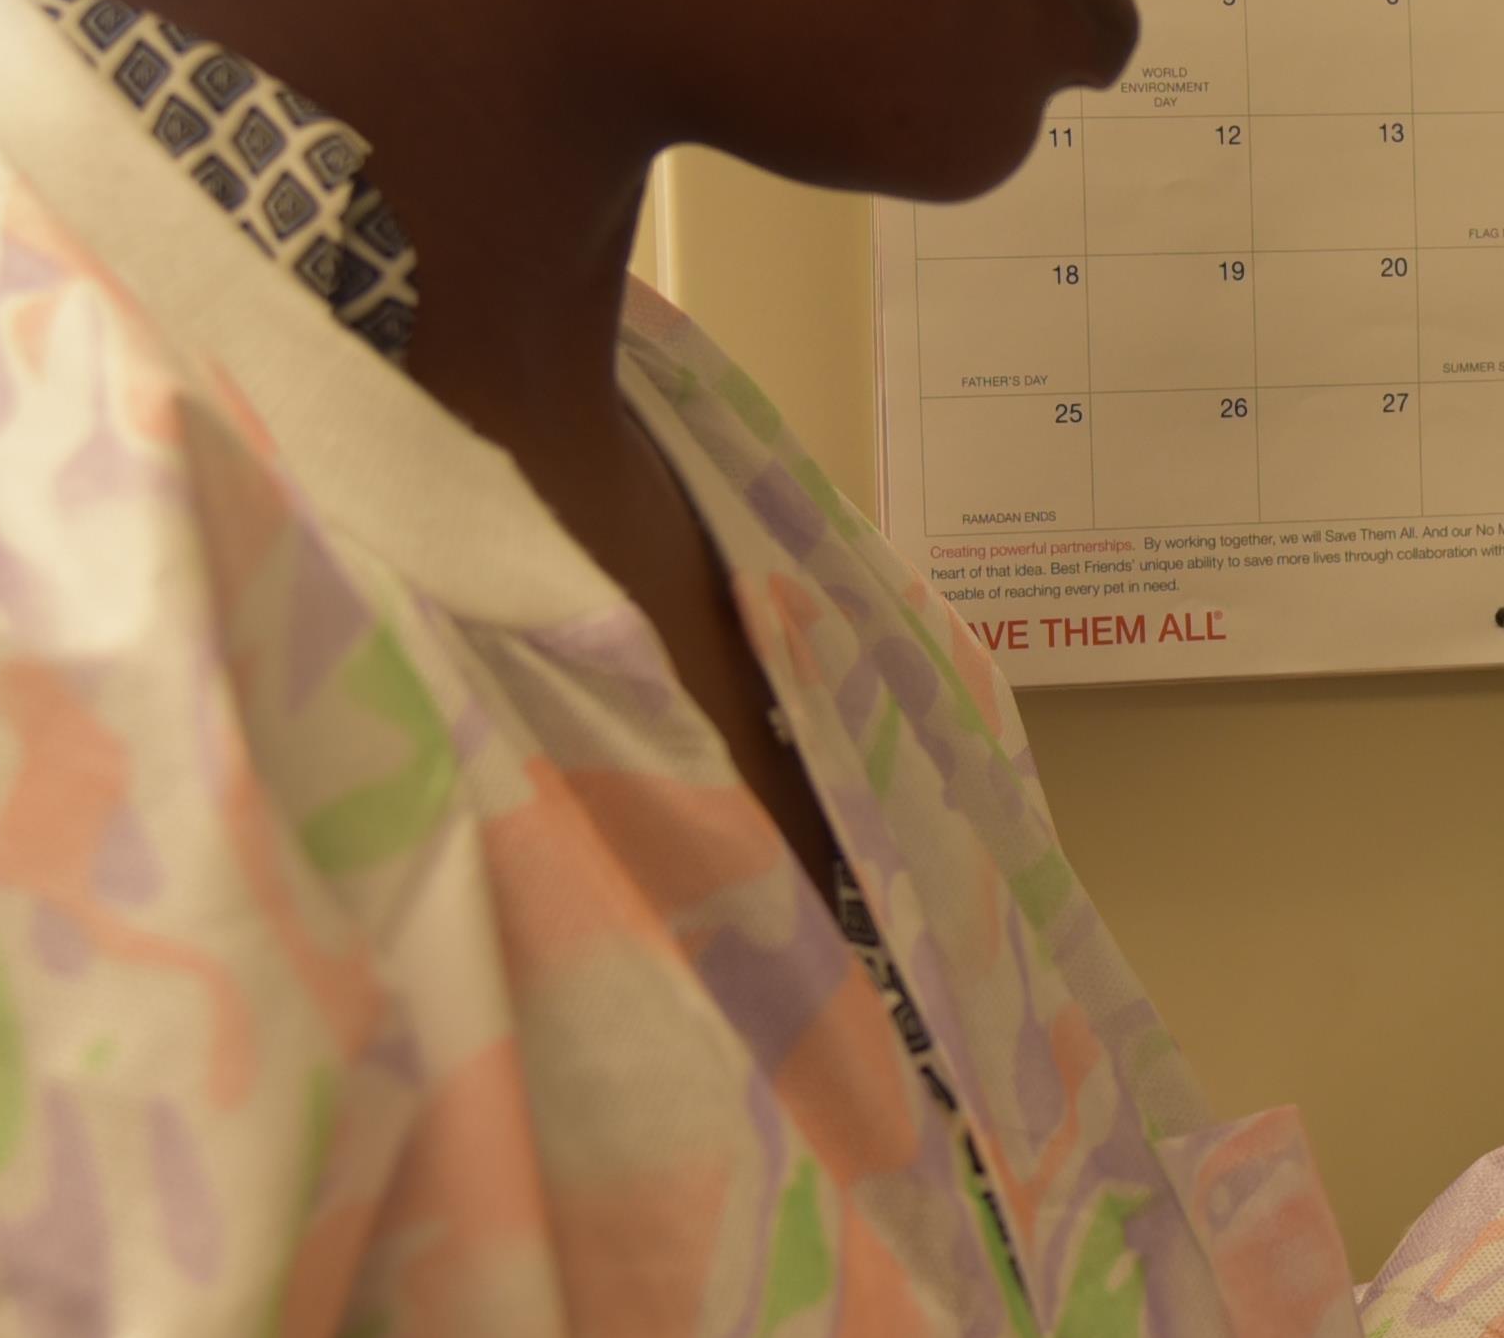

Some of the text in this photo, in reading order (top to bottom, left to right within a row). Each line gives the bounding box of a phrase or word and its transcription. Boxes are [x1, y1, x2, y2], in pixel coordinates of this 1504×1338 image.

[1142, 68, 1188, 78] WORLD
[1120, 82, 1209, 93] ENVIRONMENT
[1154, 97, 1178, 108] DAY
[1049, 128, 1072, 147] 11
[1215, 125, 1241, 146] 12
[1379, 123, 1405, 143] 13
[1469, 229, 1499, 239] FLAG
[1053, 264, 1079, 285] 18
[1219, 260, 1245, 281] 19
[1380, 257, 1408, 278] 20
[1442, 362, 1495, 374] SUMMER
[962, 375, 1048, 388] FATHER'S DAY
[1055, 403, 1083, 424] 25
[1220, 397, 1248, 419] 26
[1382, 392, 1409, 413] 27
[962, 511, 1056, 526] RAMADAN ENDS
[931, 545, 986, 560] Creating
[990, 543, 1046, 559] powerful
[1050, 540, 1135, 556] partnerships.
[1144, 536, 1161, 553] By
[1165, 536, 1216, 551] working
[1221, 533, 1276, 549] together,
[1280, 535, 1298, 544] we
[1303, 531, 1321, 543] will
[1325, 530, 1356, 542] Save
[1360, 528, 1396, 540] Them
[1400, 527, 1418, 539] All.
[1423, 526, 1448, 538] And
[1452, 527, 1472, 537] our
[1476, 525, 1494, 537] No
[931, 568, 965, 580] heart
[969, 567, 982, 578] of
[986, 565, 1011, 577] that
[1015, 565, 1046, 576] idea.
[1051, 563, 1080, 575] Best
[1085, 560, 1135, 573] Friends'
[1140, 560, 1183, 572] unique
[1187, 556, 1224, 571] ability
[1228, 556, 1240, 567] to
[1244, 556, 1273, 567] save
[1277, 554, 1310, 565] more
[1313, 552, 1341, 564] lives
[1345, 550, 1393, 564] through
[1397, 545, 1476, 560] collaboration
[941, 579, 1180, 602] apable of reaching every pet in need.
[969, 612, 1225, 650] VE THEM ALL
